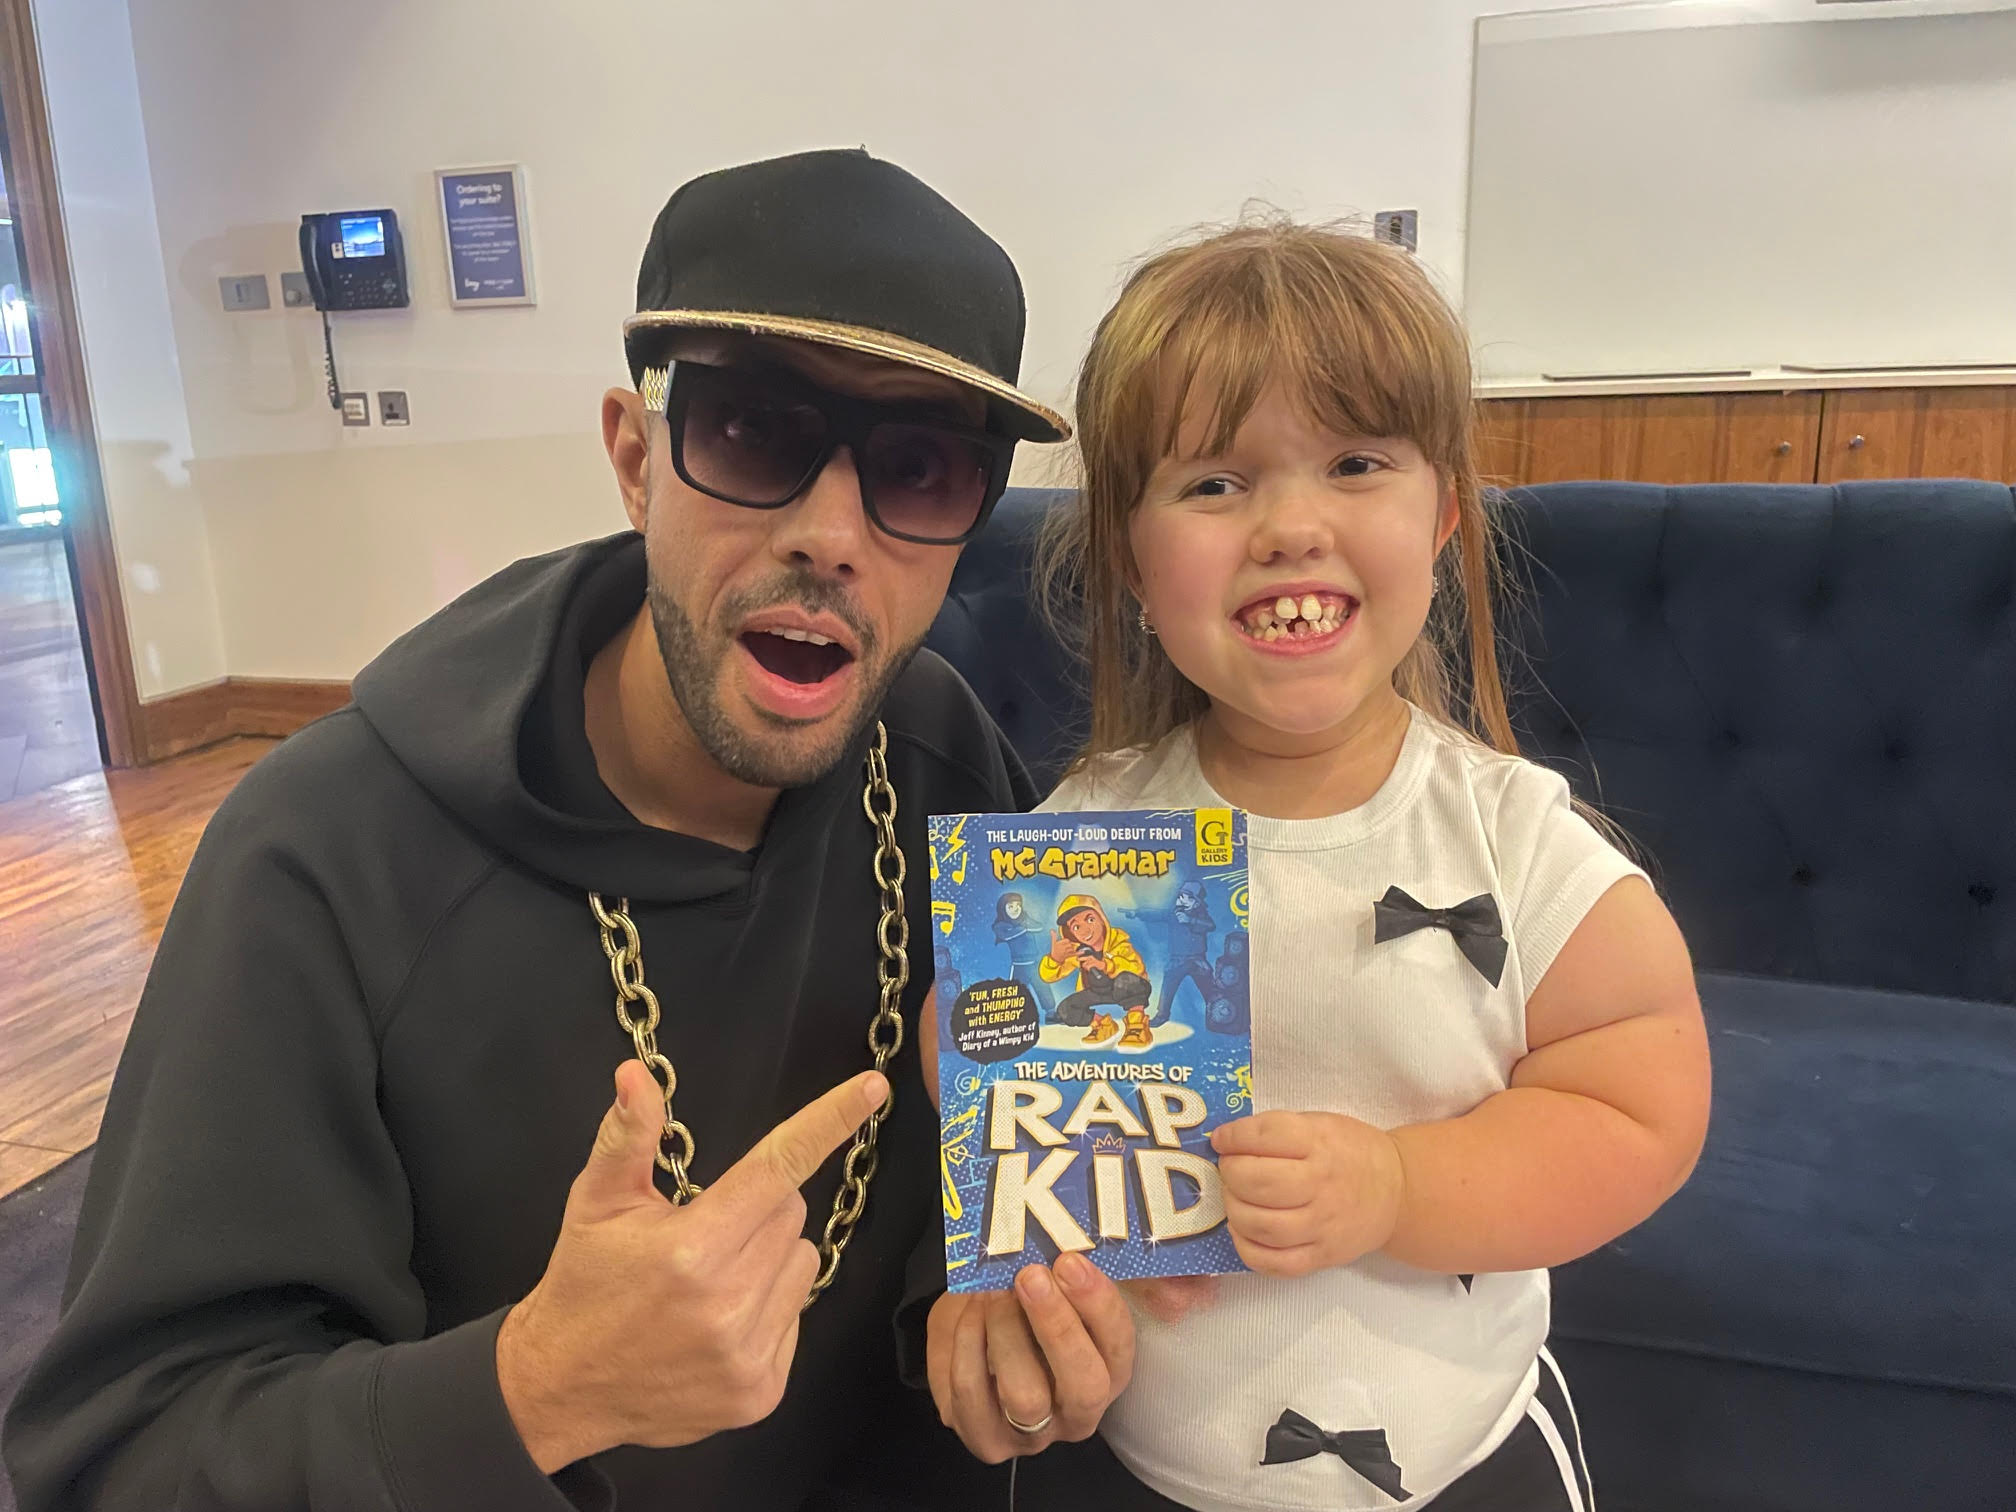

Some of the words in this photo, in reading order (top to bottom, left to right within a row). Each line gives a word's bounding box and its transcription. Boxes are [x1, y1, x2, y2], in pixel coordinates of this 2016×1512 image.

[456, 184, 491, 194] Ordering
[492, 183, 503, 192] to
[459, 197, 477, 208] your
[478, 193, 502, 204] suite?
[986, 830, 1007, 843] THE
[1009, 828, 1107, 842] LAUGH-OUT-LOUD
[1110, 828, 1146, 841] DEBUT
[1149, 828, 1182, 841] FROM
[1201, 821, 1229, 846] G
[1201, 854, 1228, 863] KIDS
[992, 985, 1019, 999] FRESH
[964, 1004, 980, 1015] and
[982, 997, 1026, 1013] THUMPING
[968, 1015, 987, 1027] with
[958, 1030, 975, 1042] Jeff
[1002, 1024, 1027, 1034] author
[1028, 1021, 1037, 1031] of
[962, 1041, 982, 1052] Diary
[983, 1039, 991, 1048] of
[998, 1035, 1022, 1045] Wimpy
[1023, 1032, 1035, 1041] Kid
[1014, 1061, 1049, 1080] THE
[1050, 1060, 1166, 1081] ADVENTURES
[1168, 1065, 1193, 1083] OF
[990, 1080, 1207, 1150] RAP
[986, 1148, 1228, 1256] KID
